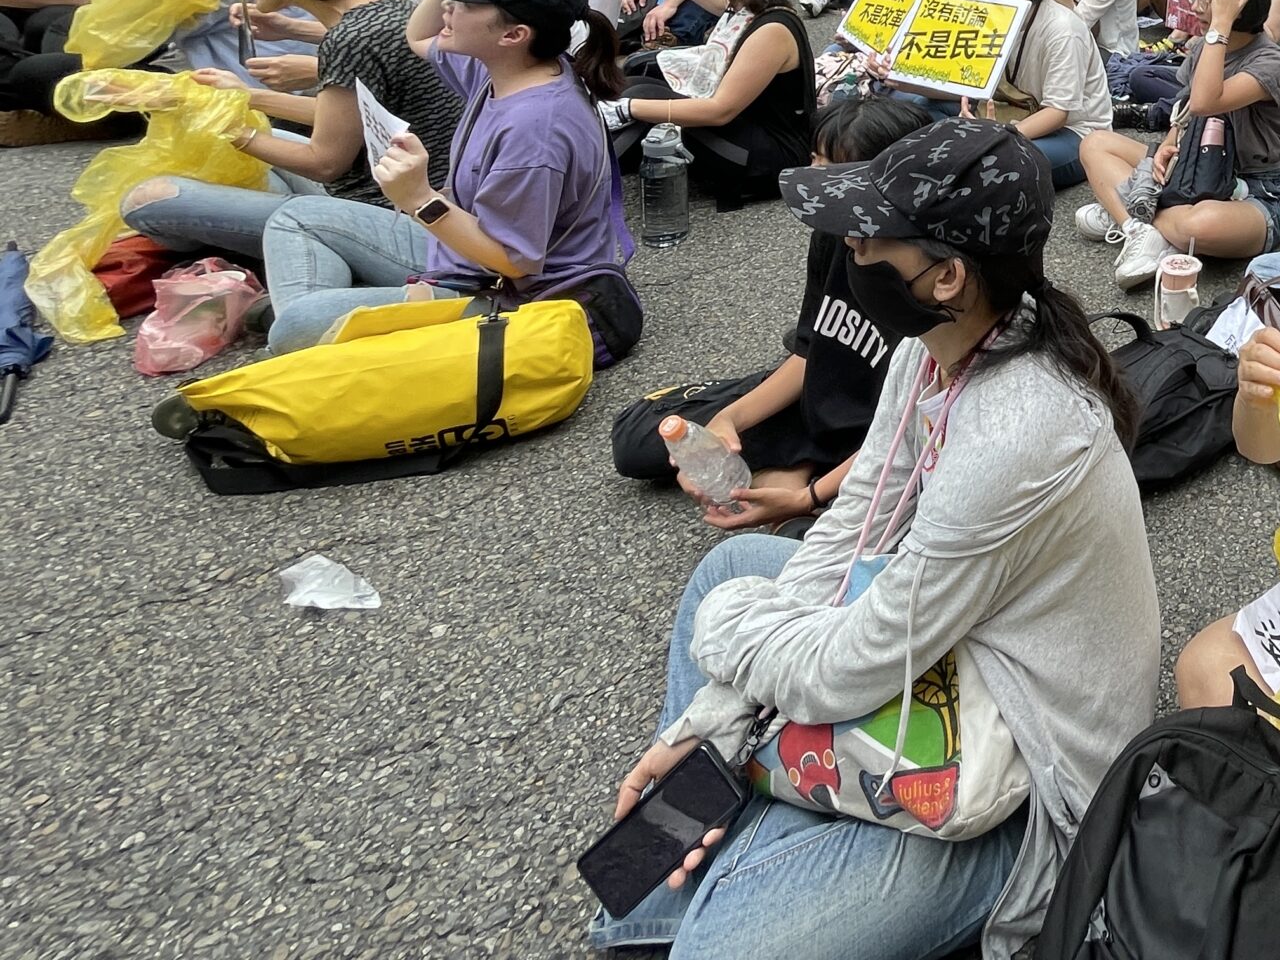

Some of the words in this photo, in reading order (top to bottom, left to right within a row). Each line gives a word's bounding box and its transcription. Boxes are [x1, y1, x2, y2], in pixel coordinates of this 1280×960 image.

[858, 1, 907, 29] 不是改革
[898, 27, 1008, 61] 不是民主
[813, 294, 889, 369] IOSITY
